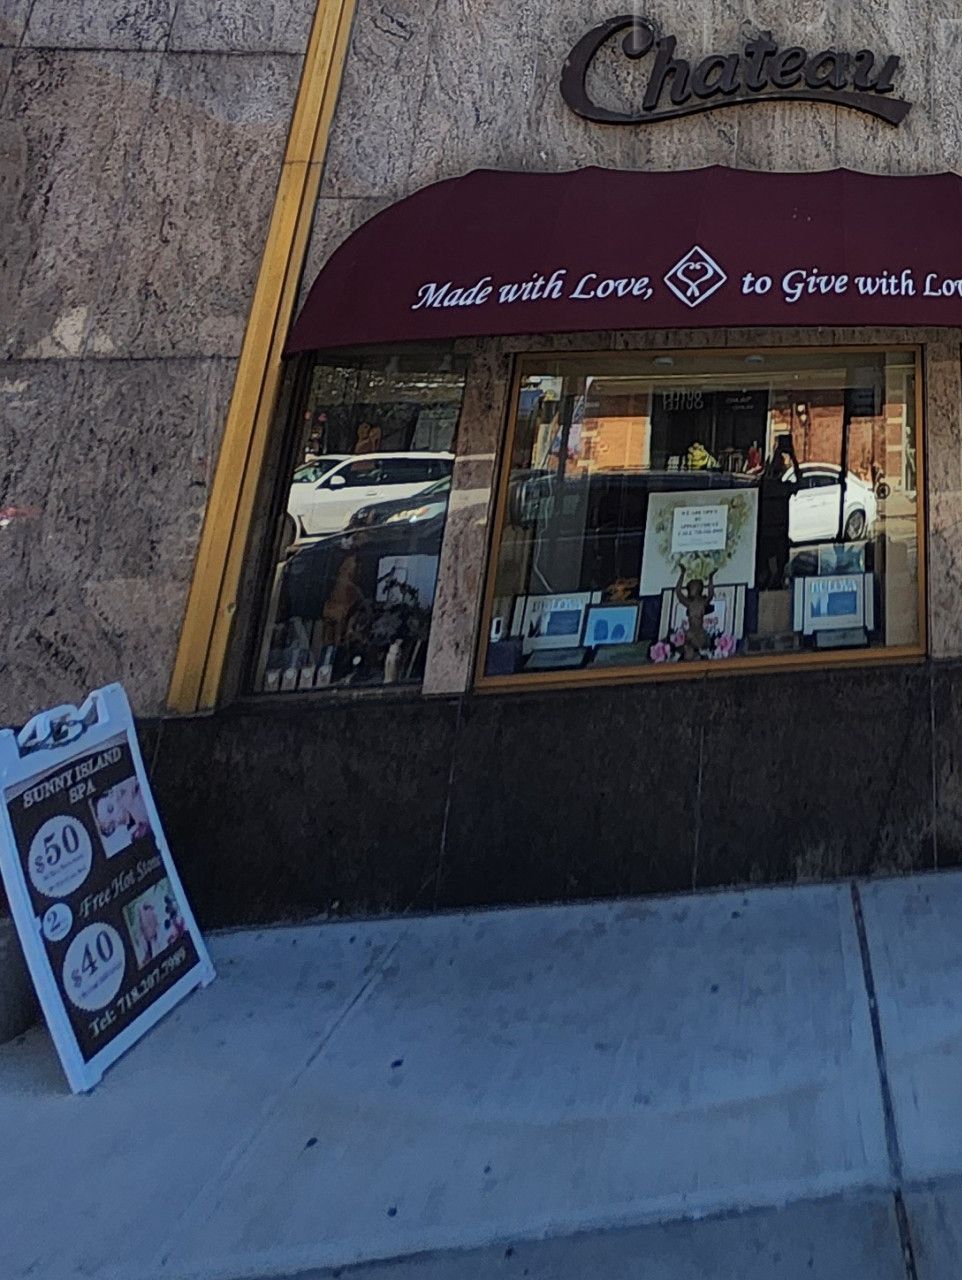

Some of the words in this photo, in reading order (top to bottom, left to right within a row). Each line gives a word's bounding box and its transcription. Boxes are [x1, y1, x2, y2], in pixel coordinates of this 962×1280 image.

[559, 14, 913, 128] Chateau
[411, 276, 493, 310] Made
[498, 269, 566, 304] with
[569, 273, 654, 301] Love,
[741, 272, 772, 295] to
[782, 268, 849, 303] Give
[854, 269, 917, 296] with
[23, 768, 73, 809] SUNNY
[75, 747, 122, 780] ISLAND
[69, 779, 96, 804] SPA
[34, 824, 80, 874] $50
[71, 930, 114, 989] $40
